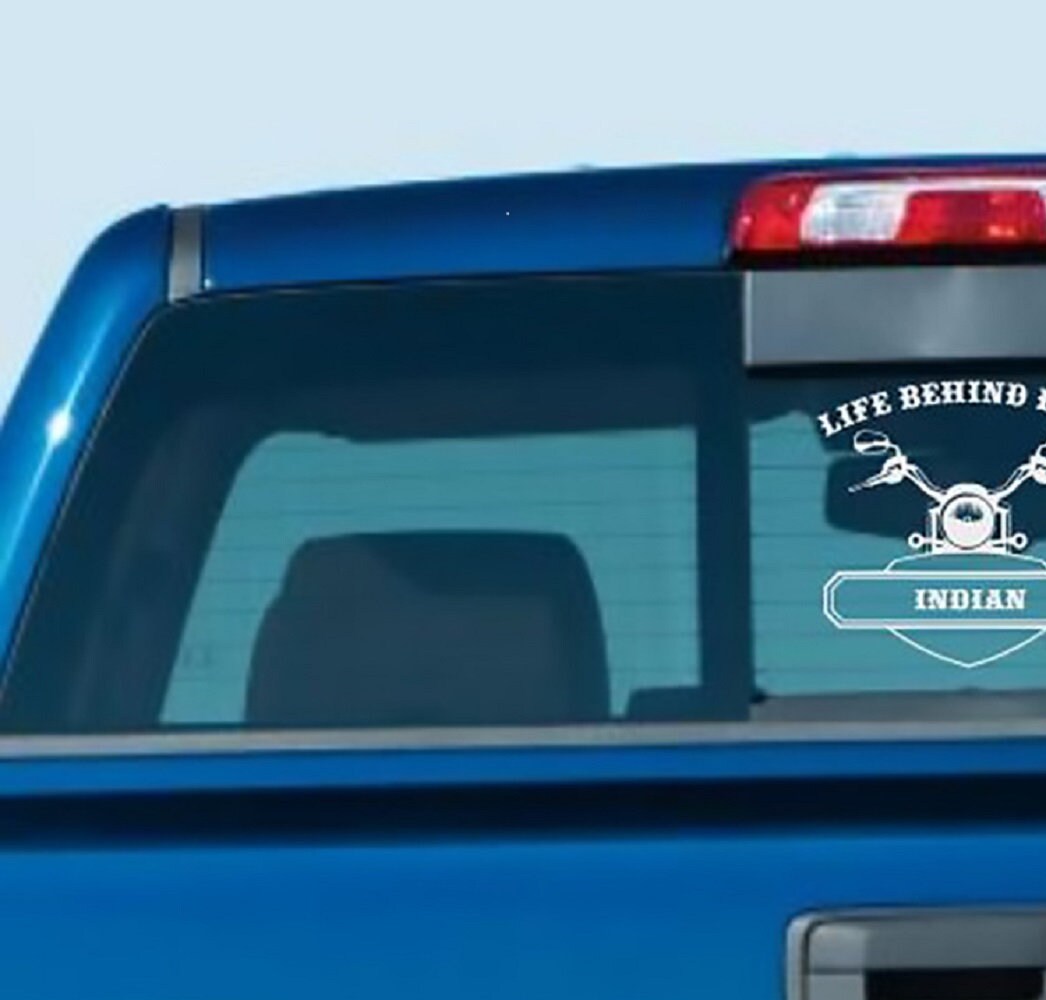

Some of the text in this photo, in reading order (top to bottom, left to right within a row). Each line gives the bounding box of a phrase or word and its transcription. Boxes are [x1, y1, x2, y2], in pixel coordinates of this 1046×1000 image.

[818, 391, 892, 437] LIFE
[899, 380, 1028, 410] BEHIND
[914, 588, 1027, 610] INDIAN
